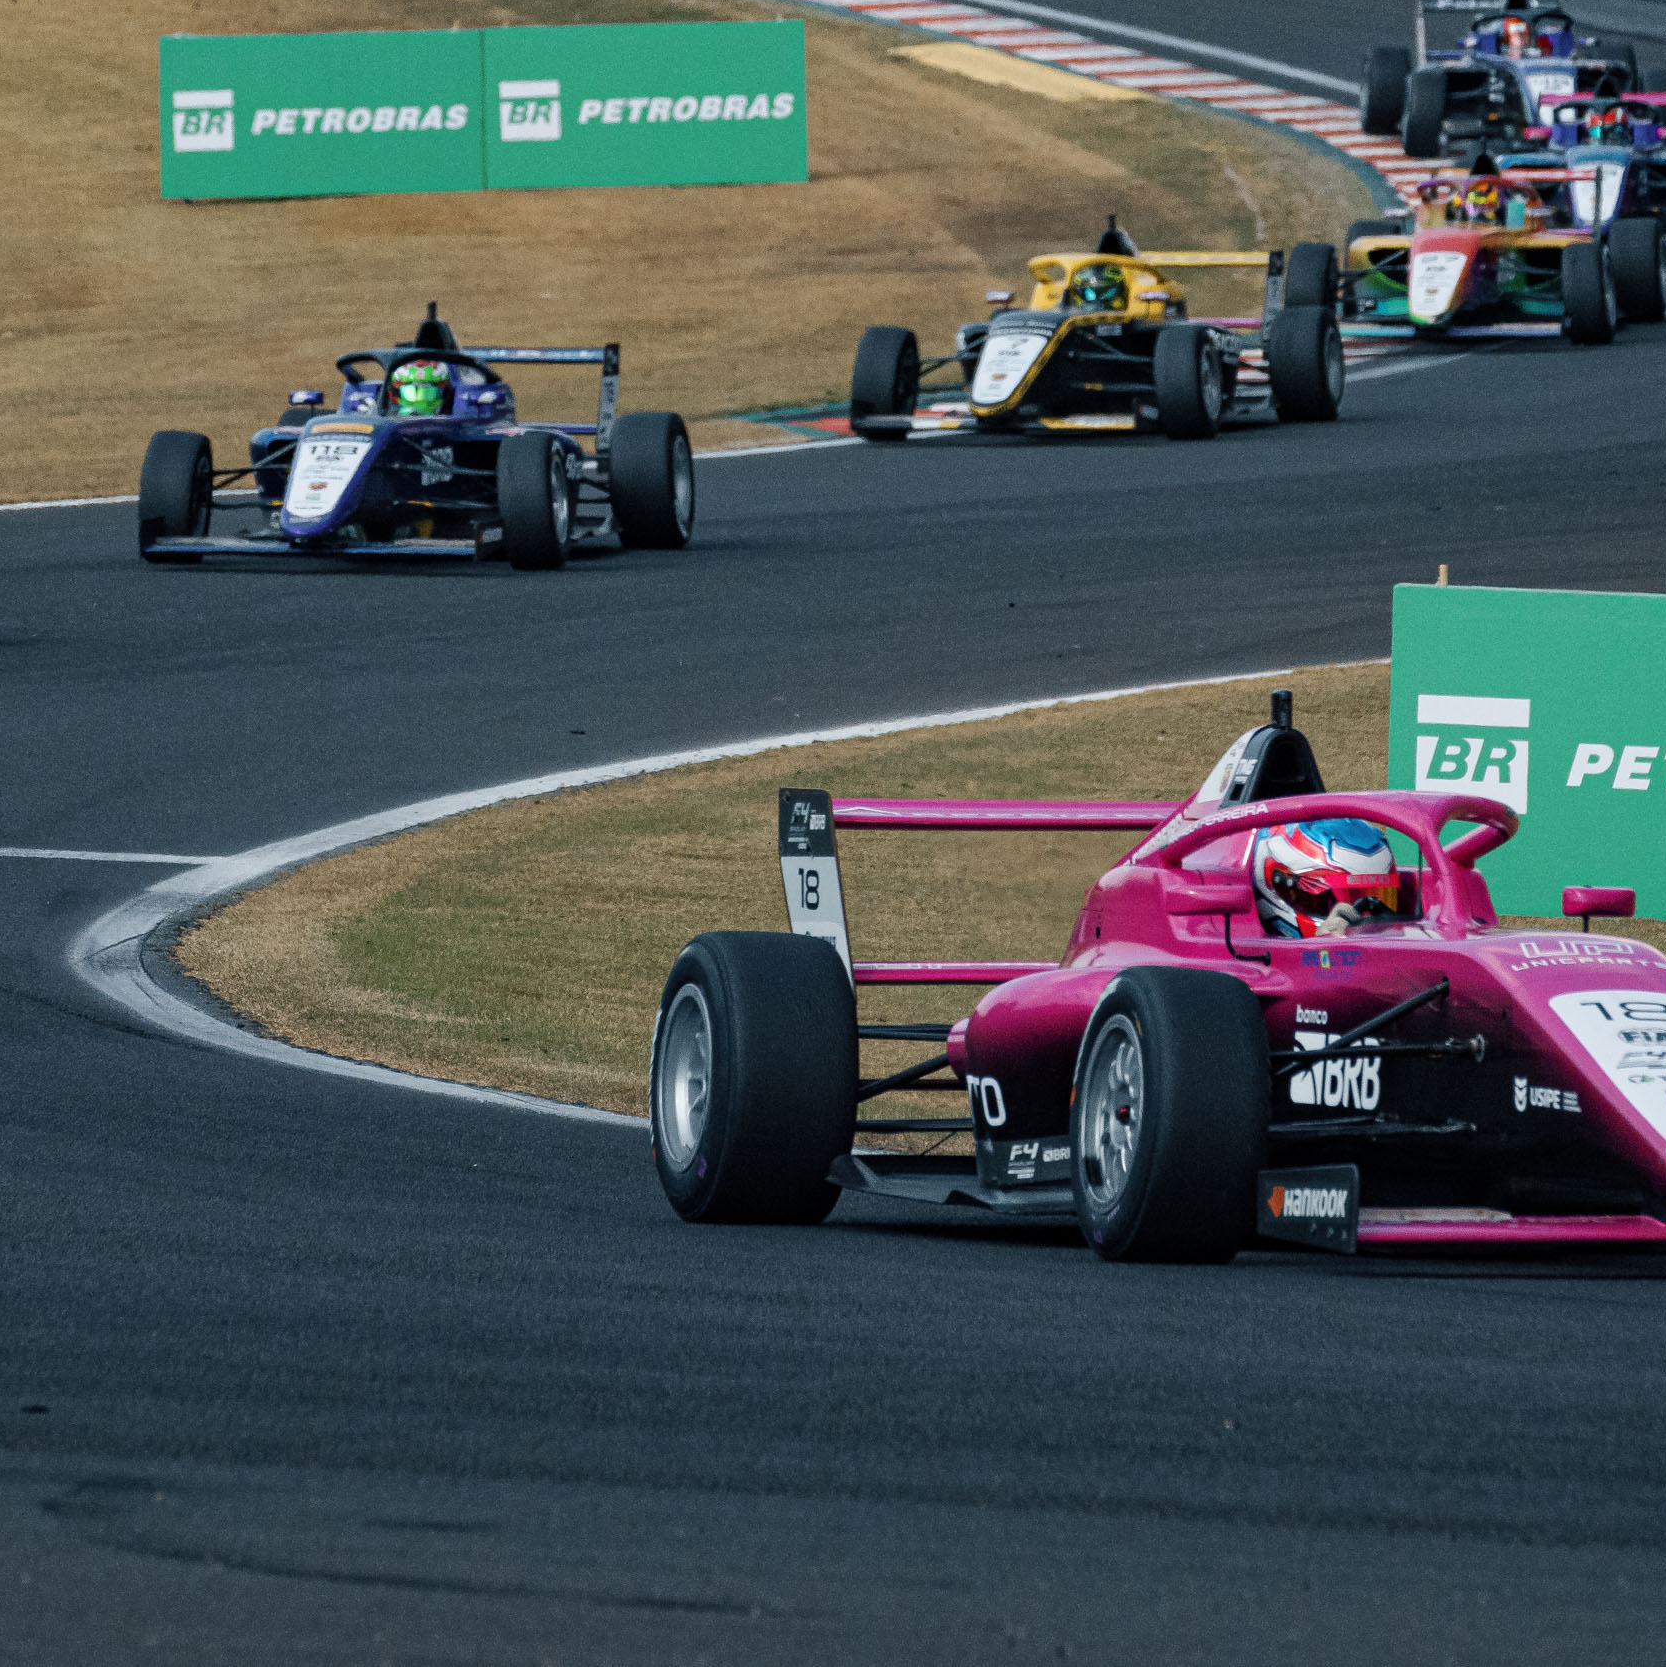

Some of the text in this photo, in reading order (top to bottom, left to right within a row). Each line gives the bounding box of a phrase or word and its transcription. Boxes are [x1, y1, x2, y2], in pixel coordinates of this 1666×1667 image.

[182, 103, 469, 136] BR PETROBRAS
[508, 92, 795, 125] BR PETROBRAS
[1426, 735, 1517, 783] BR
[798, 867, 820, 911] 18
[1295, 1004, 1329, 1025] banco
[1009, 1142, 1040, 1161] F4
